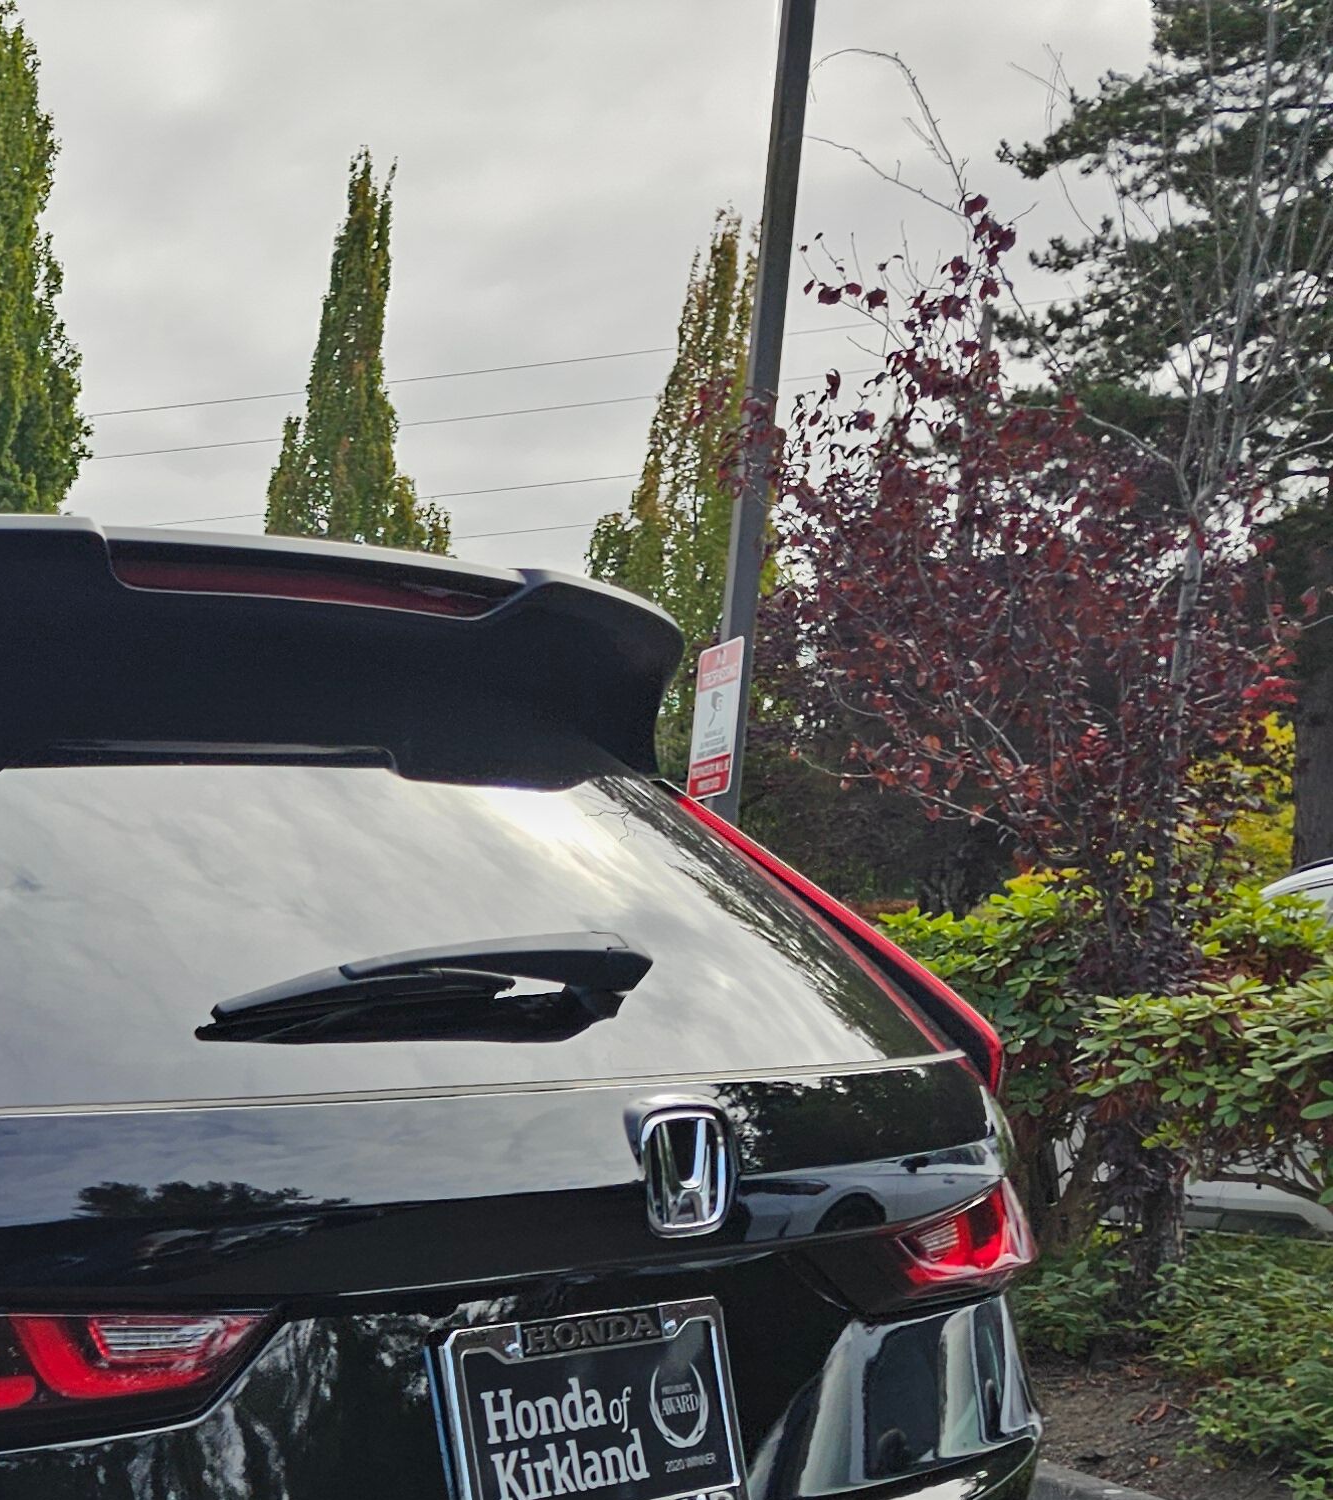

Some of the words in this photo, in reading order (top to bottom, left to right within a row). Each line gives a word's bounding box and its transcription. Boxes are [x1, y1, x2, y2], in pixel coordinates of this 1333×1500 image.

[523, 1312, 661, 1353] HONDA
[480, 1377, 608, 1444] Honda
[609, 1386, 632, 1433] of
[661, 1393, 700, 1417] AWARD
